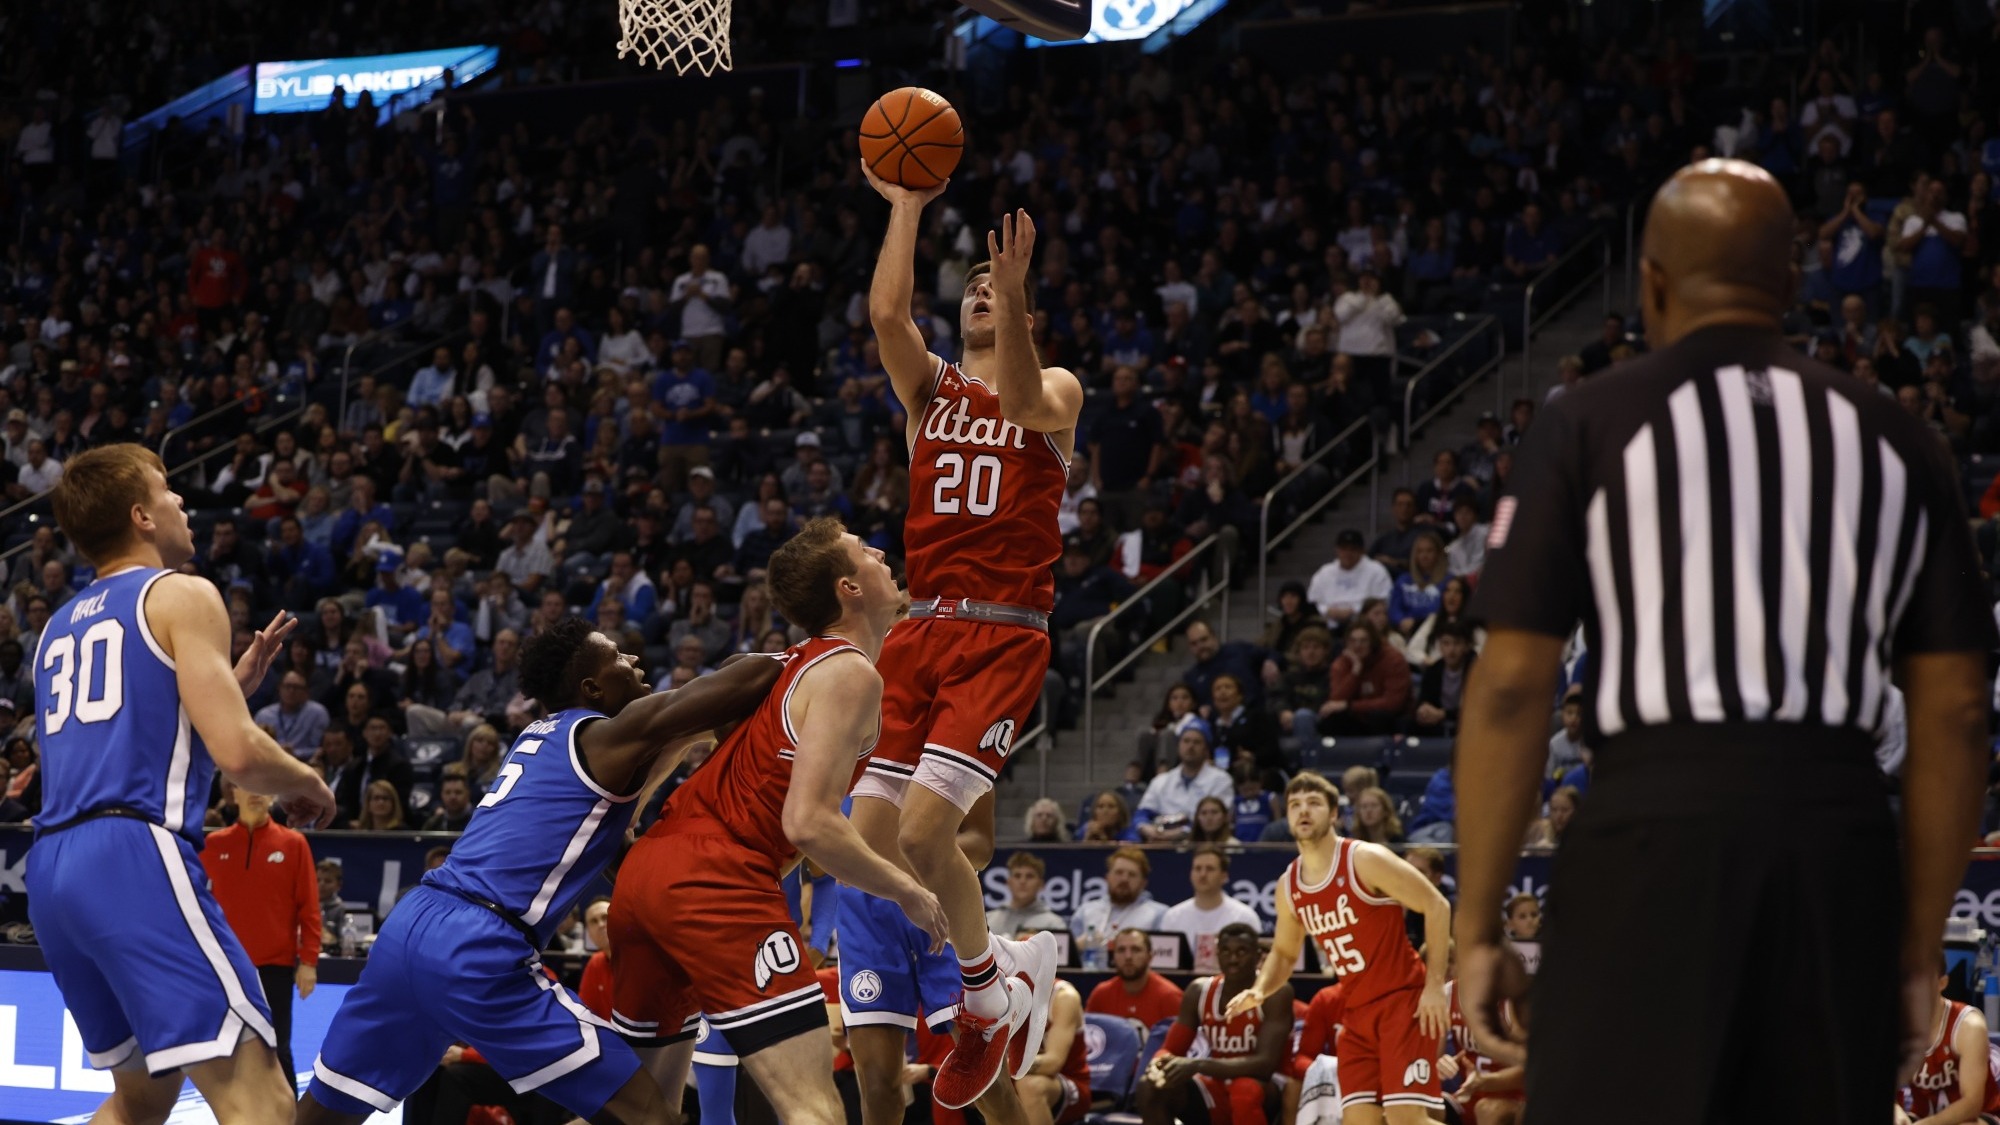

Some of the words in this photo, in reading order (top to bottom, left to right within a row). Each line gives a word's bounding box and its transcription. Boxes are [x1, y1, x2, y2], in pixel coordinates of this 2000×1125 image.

[933, 452, 1002, 517] 20
[70, 589, 110, 625] HALL
[43, 617, 125, 736] 30
[1297, 893, 1359, 936] Utah
[1323, 933, 1366, 977] 25
